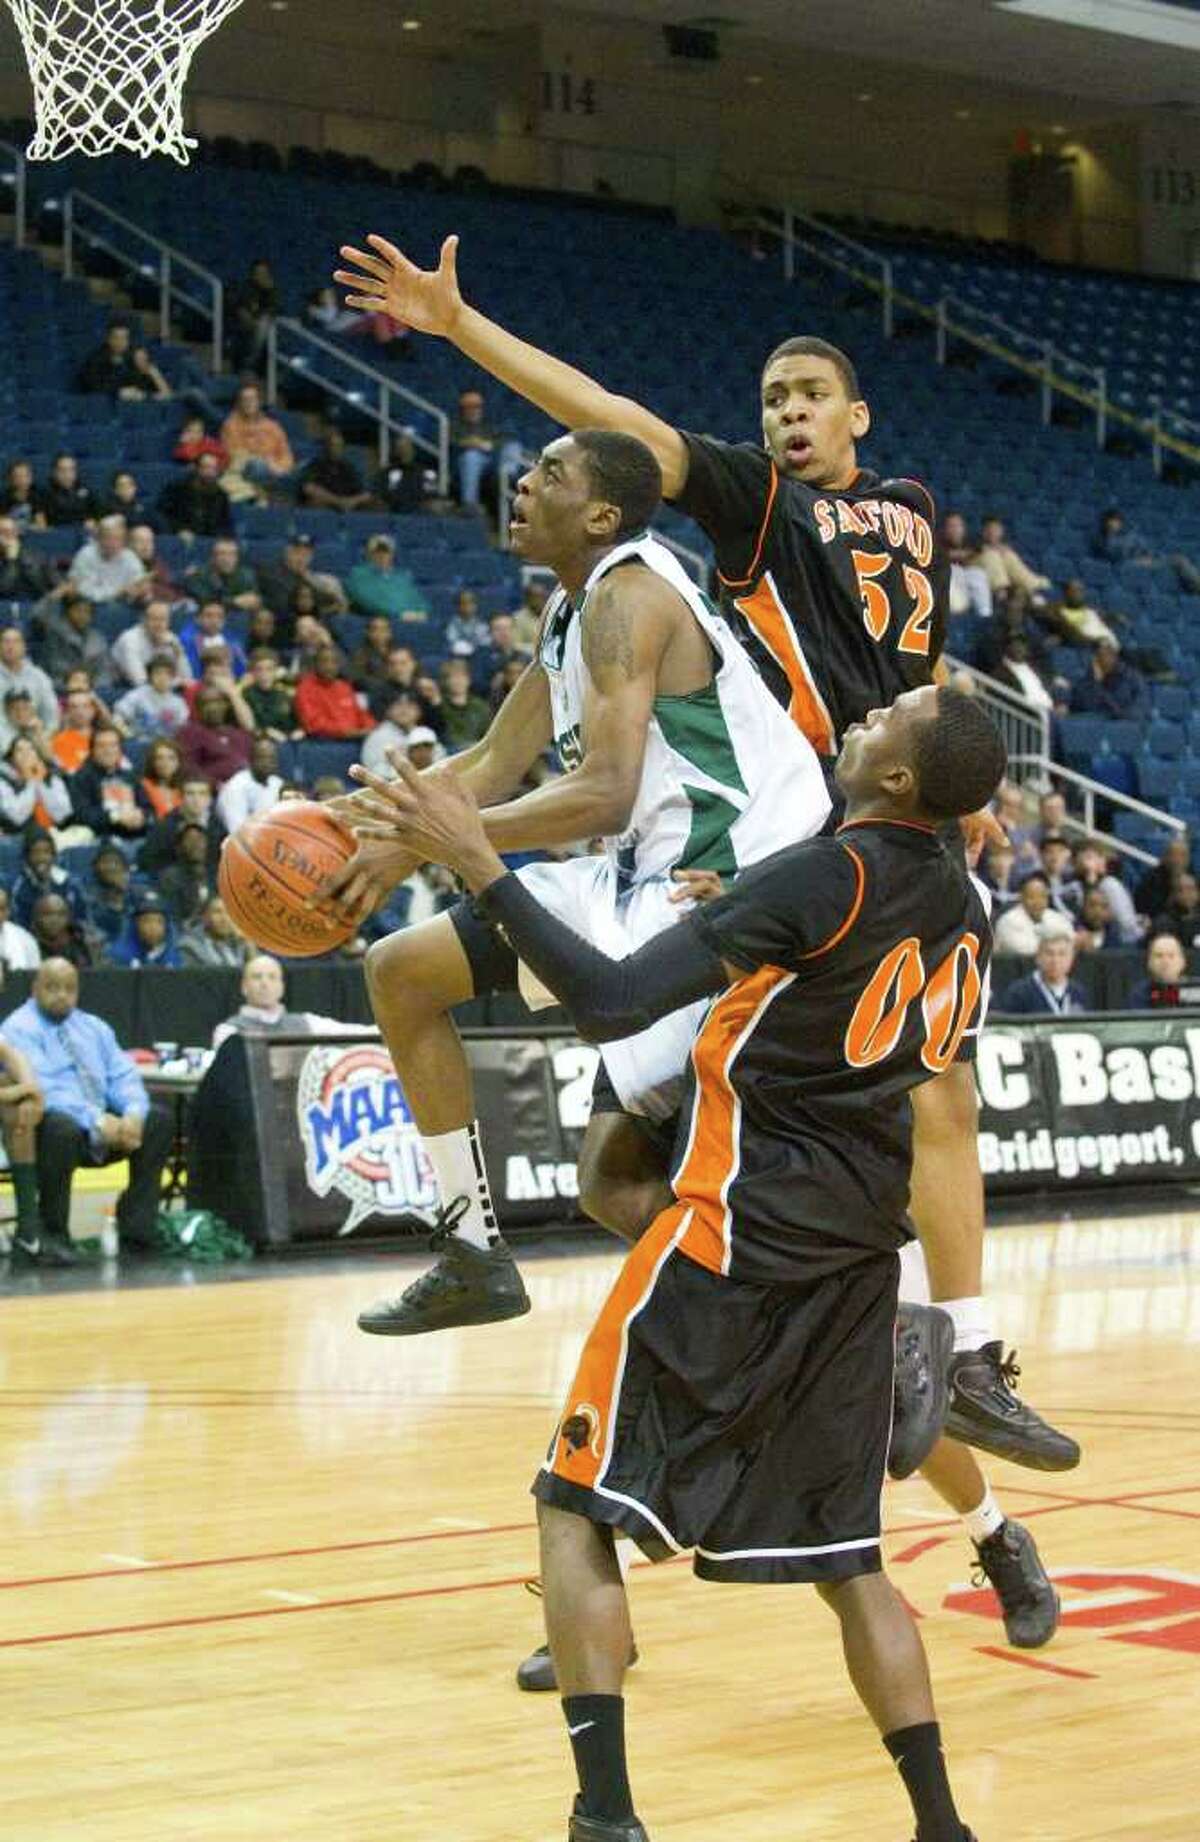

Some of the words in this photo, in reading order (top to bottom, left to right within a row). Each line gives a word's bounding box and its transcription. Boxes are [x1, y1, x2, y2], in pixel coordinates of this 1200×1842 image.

[542, 73, 598, 114] 114
[852, 550, 934, 656] 52
[845, 932, 981, 1073] 00
[976, 1033, 1031, 1110] C
[308, 1078, 416, 1174] MAA
[506, 1155, 580, 1200] Are
[977, 1124, 1184, 1179] Bridgeport,
